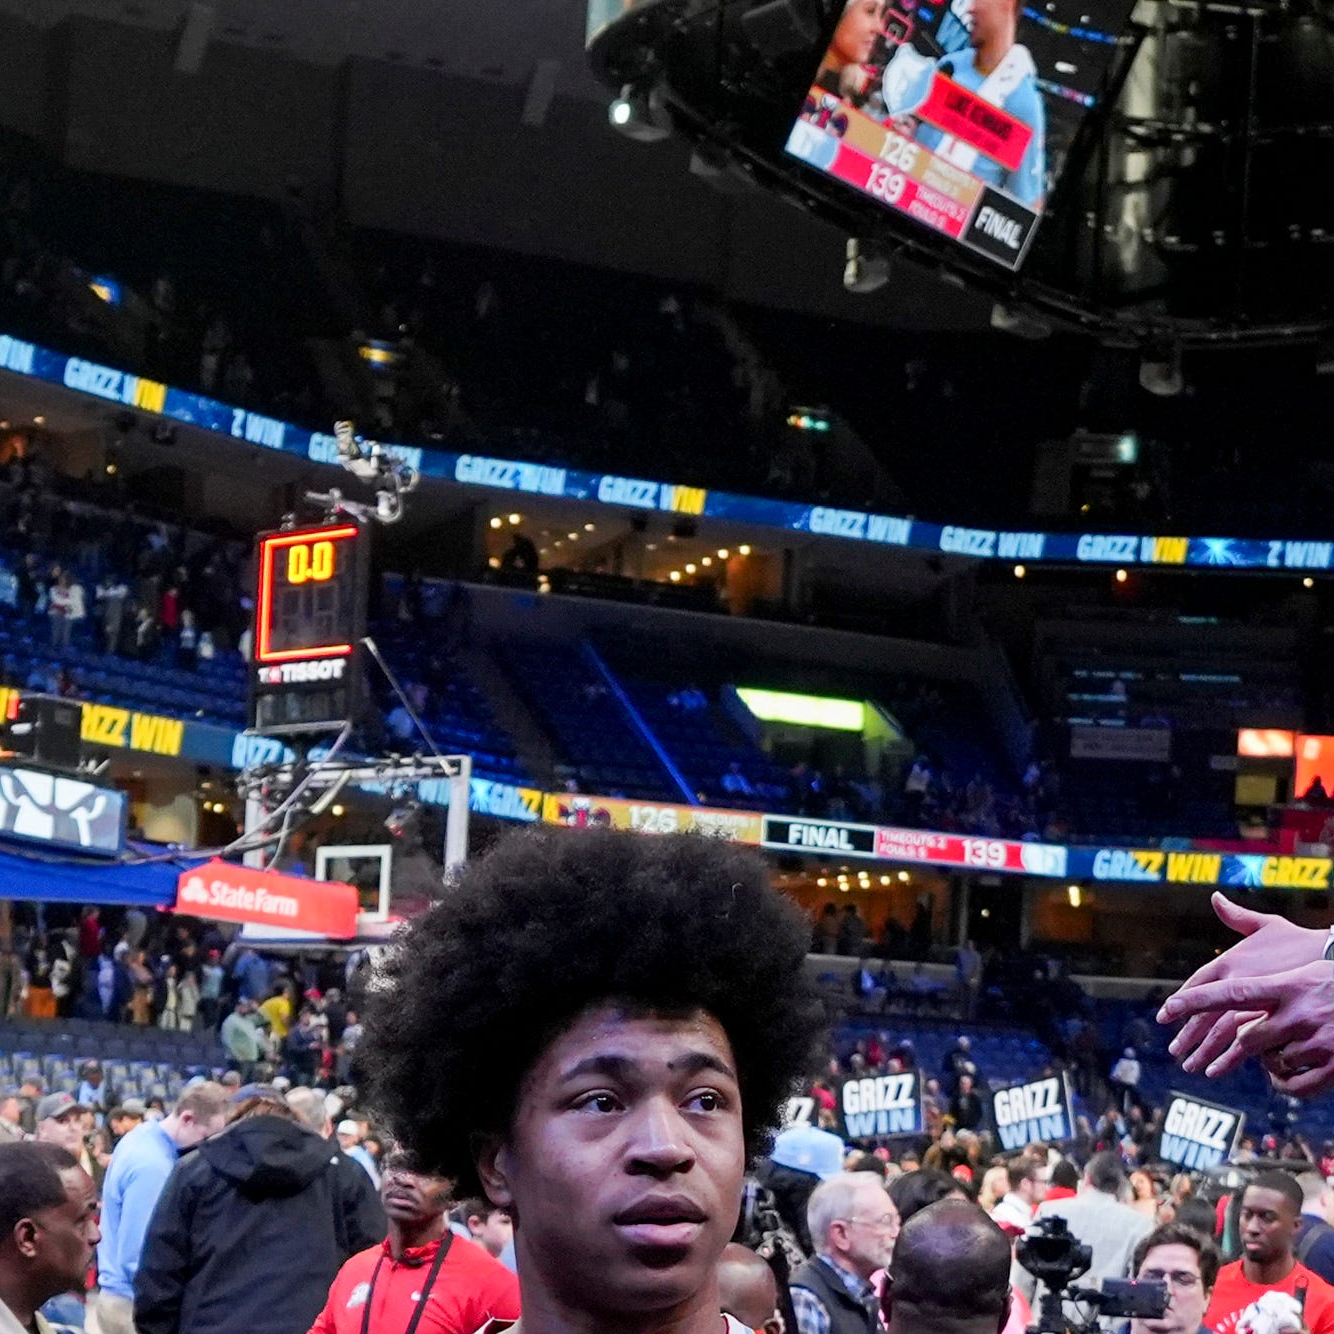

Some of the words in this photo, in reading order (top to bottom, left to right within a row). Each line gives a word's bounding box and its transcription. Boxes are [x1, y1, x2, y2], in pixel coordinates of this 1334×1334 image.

[879, 132, 921, 176] 126
[866, 163, 907, 205] 139
[975, 206, 1023, 250] FINAL
[64, 357, 125, 402] GRIZZ
[123, 373, 167, 414] WIN
[245, 413, 285, 451] WIN
[455, 454, 521, 490] GRIZZ
[519, 463, 566, 497] WIN
[598, 476, 655, 509] GRIZZ
[659, 483, 706, 516] WIN
[809, 506, 866, 540] GRIZZ
[867, 512, 912, 545] WIN
[939, 525, 998, 559] GRIZZ
[998, 532, 1045, 560] WIN
[288, 541, 334, 584] 0.0
[1076, 533, 1138, 563] GRIZZ
[1140, 536, 1188, 564] WIN
[1284, 540, 1333, 569] WIN
[281, 658, 346, 684] TISSOT
[131, 712, 184, 757] WIN
[788, 824, 854, 850] FINAL
[880, 830, 934, 848] TIMEOUTS
[961, 839, 1006, 867] 139
[1093, 850, 1165, 882] GRIZZ
[1168, 852, 1221, 884] WIN
[1261, 854, 1334, 889] GRIZZ
[208, 881, 254, 911] State
[253, 888, 299, 918] Farm
[842, 1071, 916, 1115] GRIZZ
[993, 1076, 1062, 1126] GRIZZ
[844, 1106, 915, 1138] WIN
[998, 1114, 1066, 1151] WIN
[1163, 1098, 1237, 1151] GRIZZ
[1160, 1131, 1225, 1171] WIN
